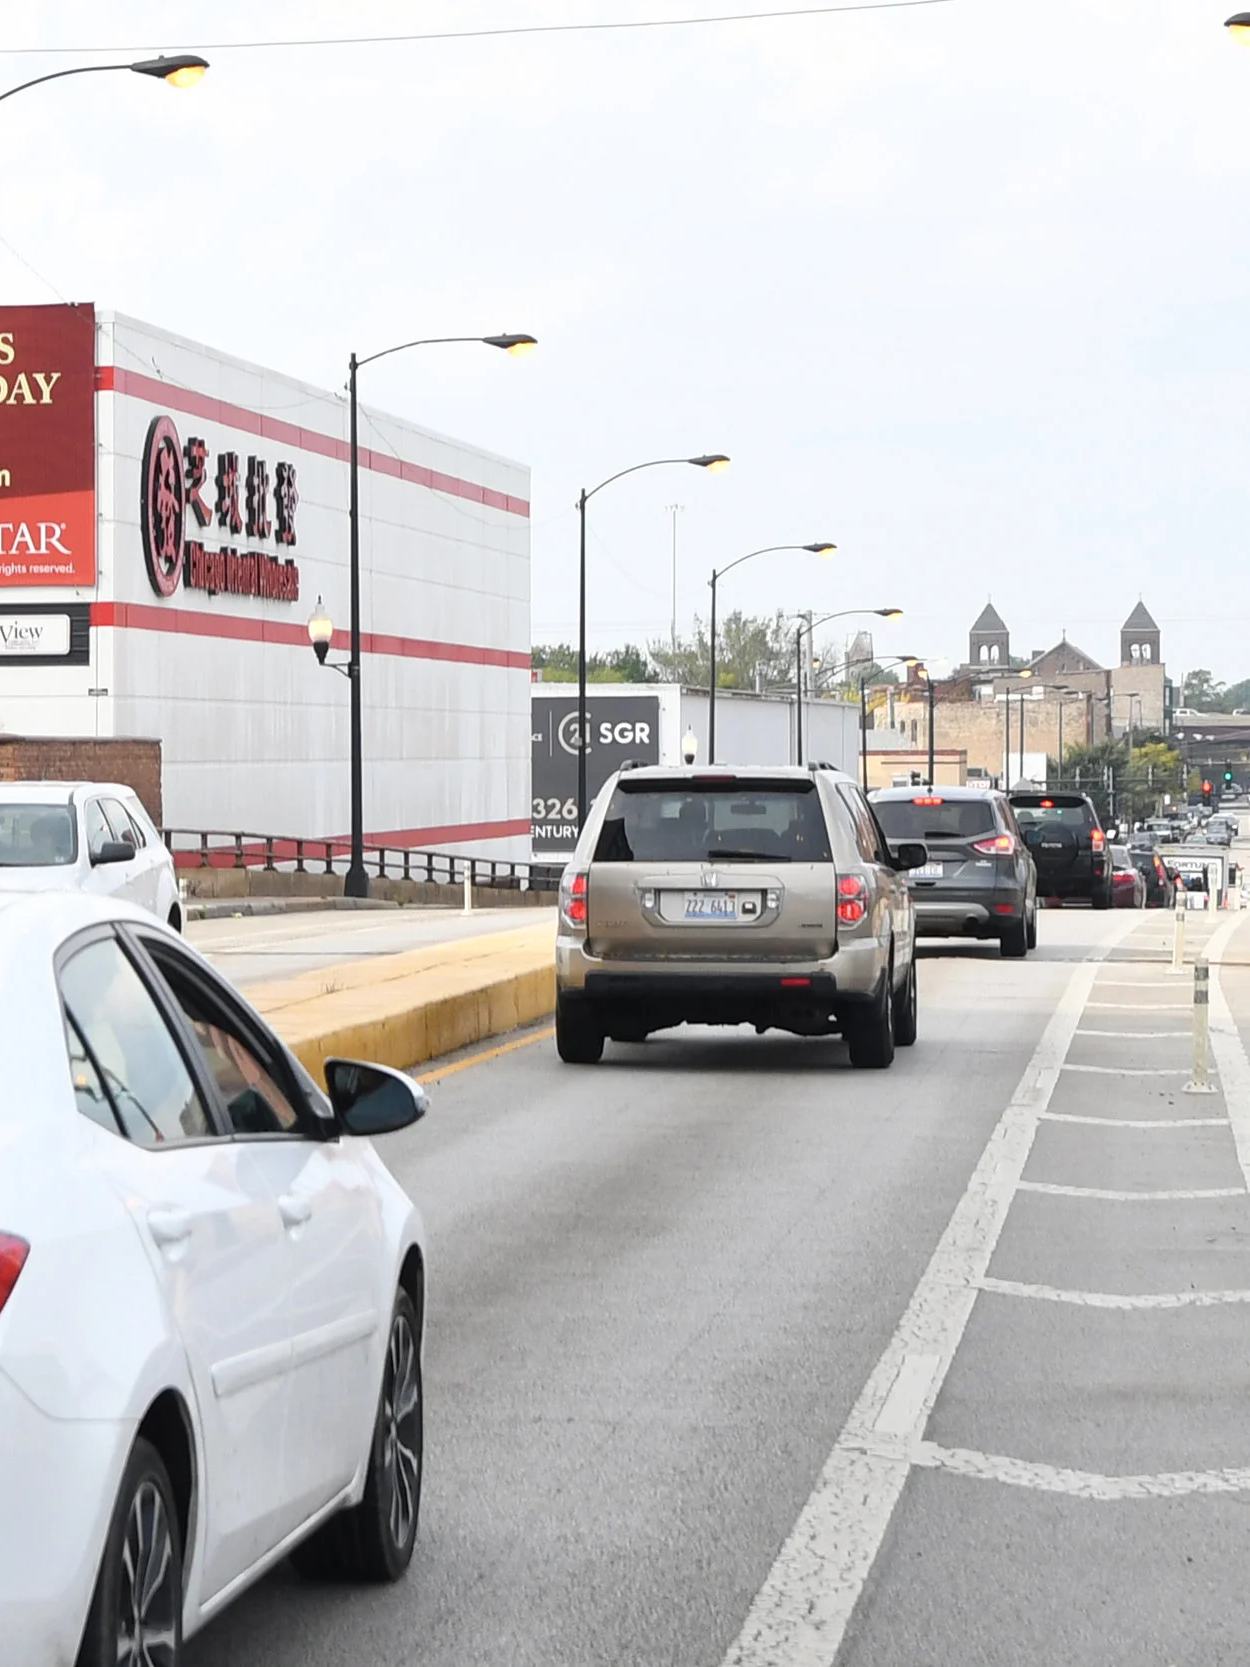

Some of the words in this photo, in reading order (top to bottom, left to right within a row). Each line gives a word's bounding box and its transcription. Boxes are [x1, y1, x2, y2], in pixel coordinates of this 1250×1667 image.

[29, 561, 75, 574] reserved.
[0, 621, 43, 643] View
[599, 722, 650, 744] SGR
[532, 797, 578, 820] 326
